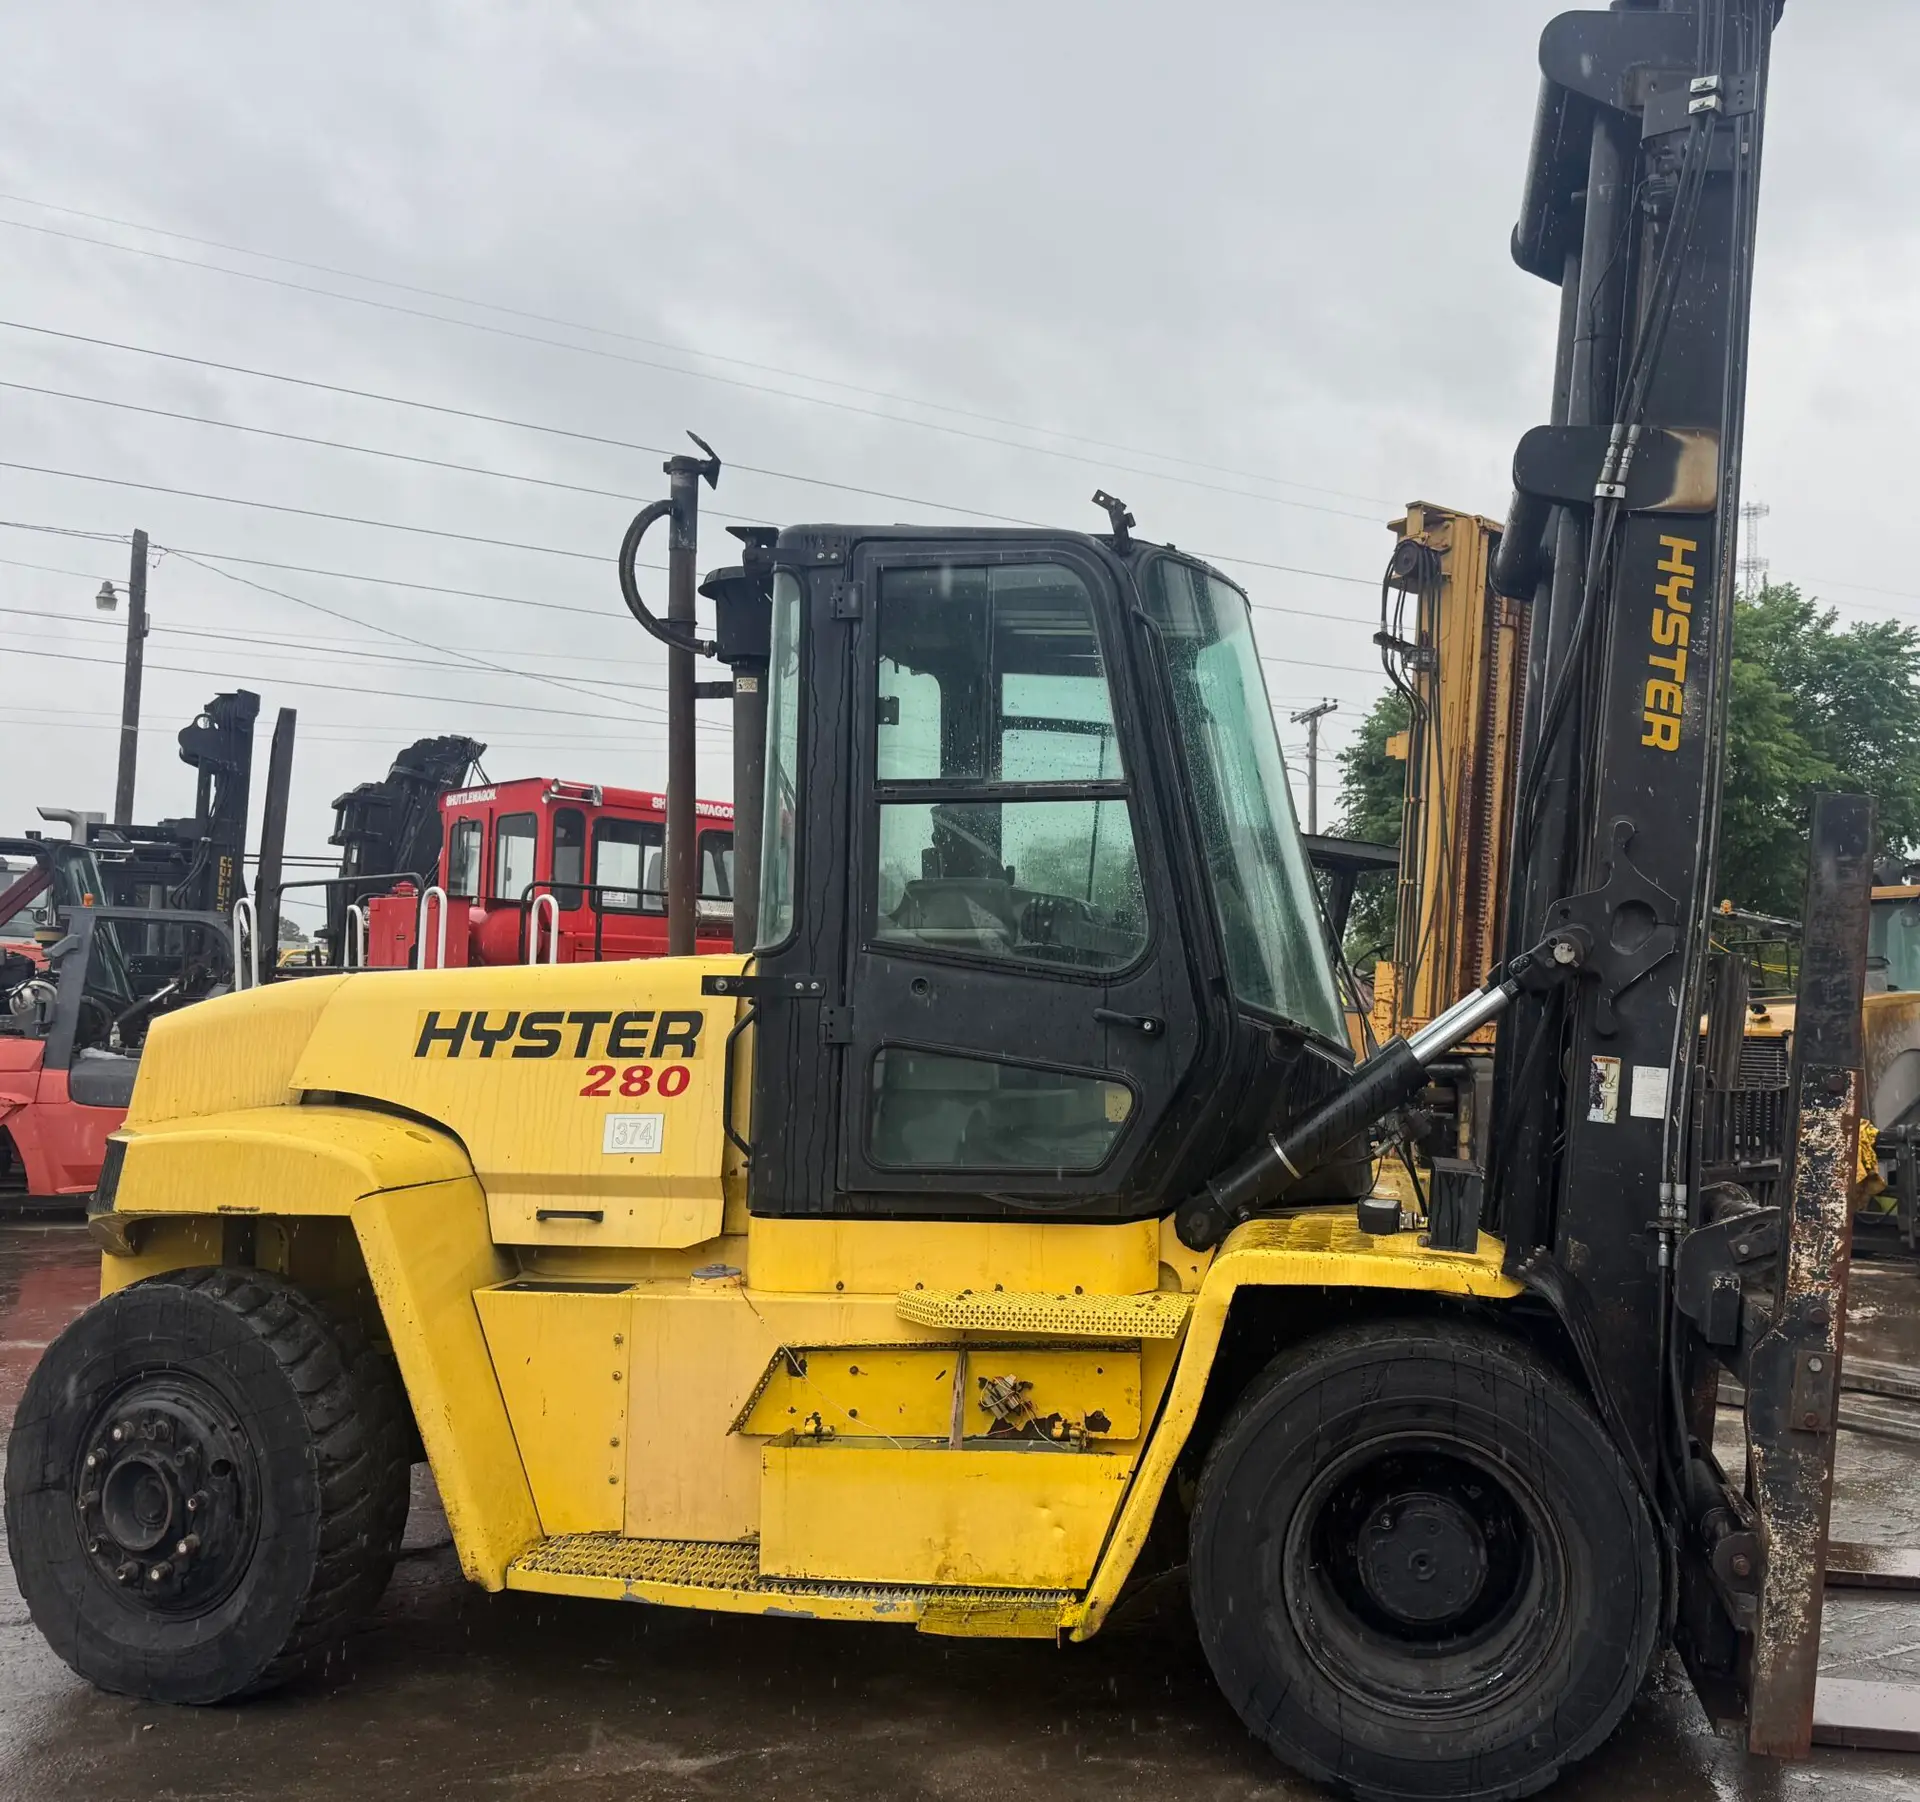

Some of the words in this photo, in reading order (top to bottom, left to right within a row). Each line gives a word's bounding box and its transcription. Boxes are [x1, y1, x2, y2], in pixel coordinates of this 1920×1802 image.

[1641, 535, 1697, 751] HYSTER
[652, 797, 734, 818] SHEWAGON
[414, 1010, 704, 1059] HYSTER
[579, 1065, 691, 1097] 280
[615, 1122, 653, 1145] 374
